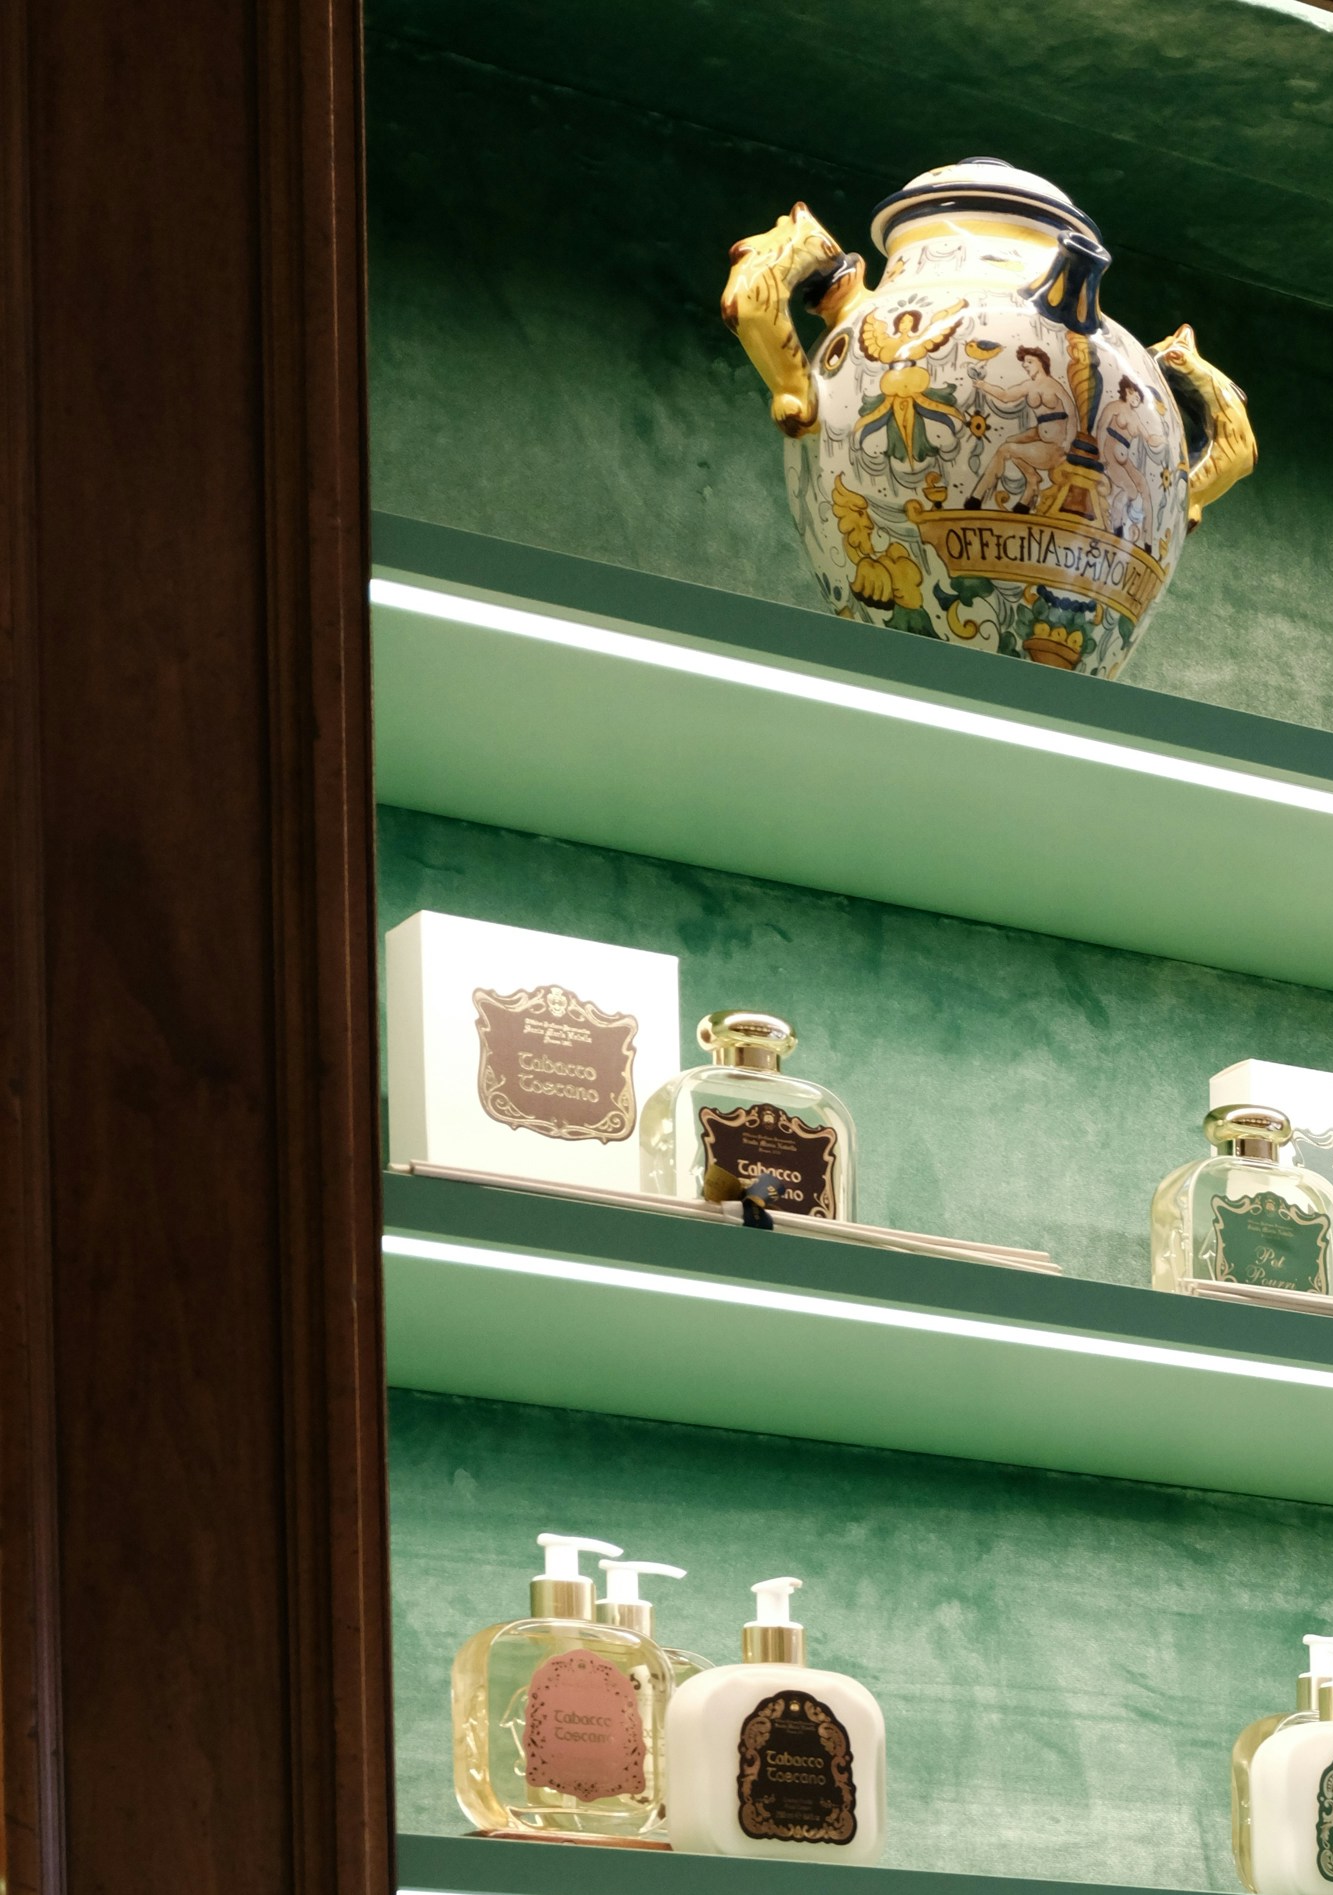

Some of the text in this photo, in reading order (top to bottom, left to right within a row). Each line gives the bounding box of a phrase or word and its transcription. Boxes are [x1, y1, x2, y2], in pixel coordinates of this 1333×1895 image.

[946, 526, 1061, 566] OFFICINA
[518, 1051, 597, 1081] Tabacco
[518, 1074, 599, 1103] Toscano
[737, 1159, 802, 1183] Tabacco
[1255, 1245, 1285, 1269] Pot
[766, 1750, 825, 1769] Tabacco
[766, 1767, 827, 1787] Toscano
